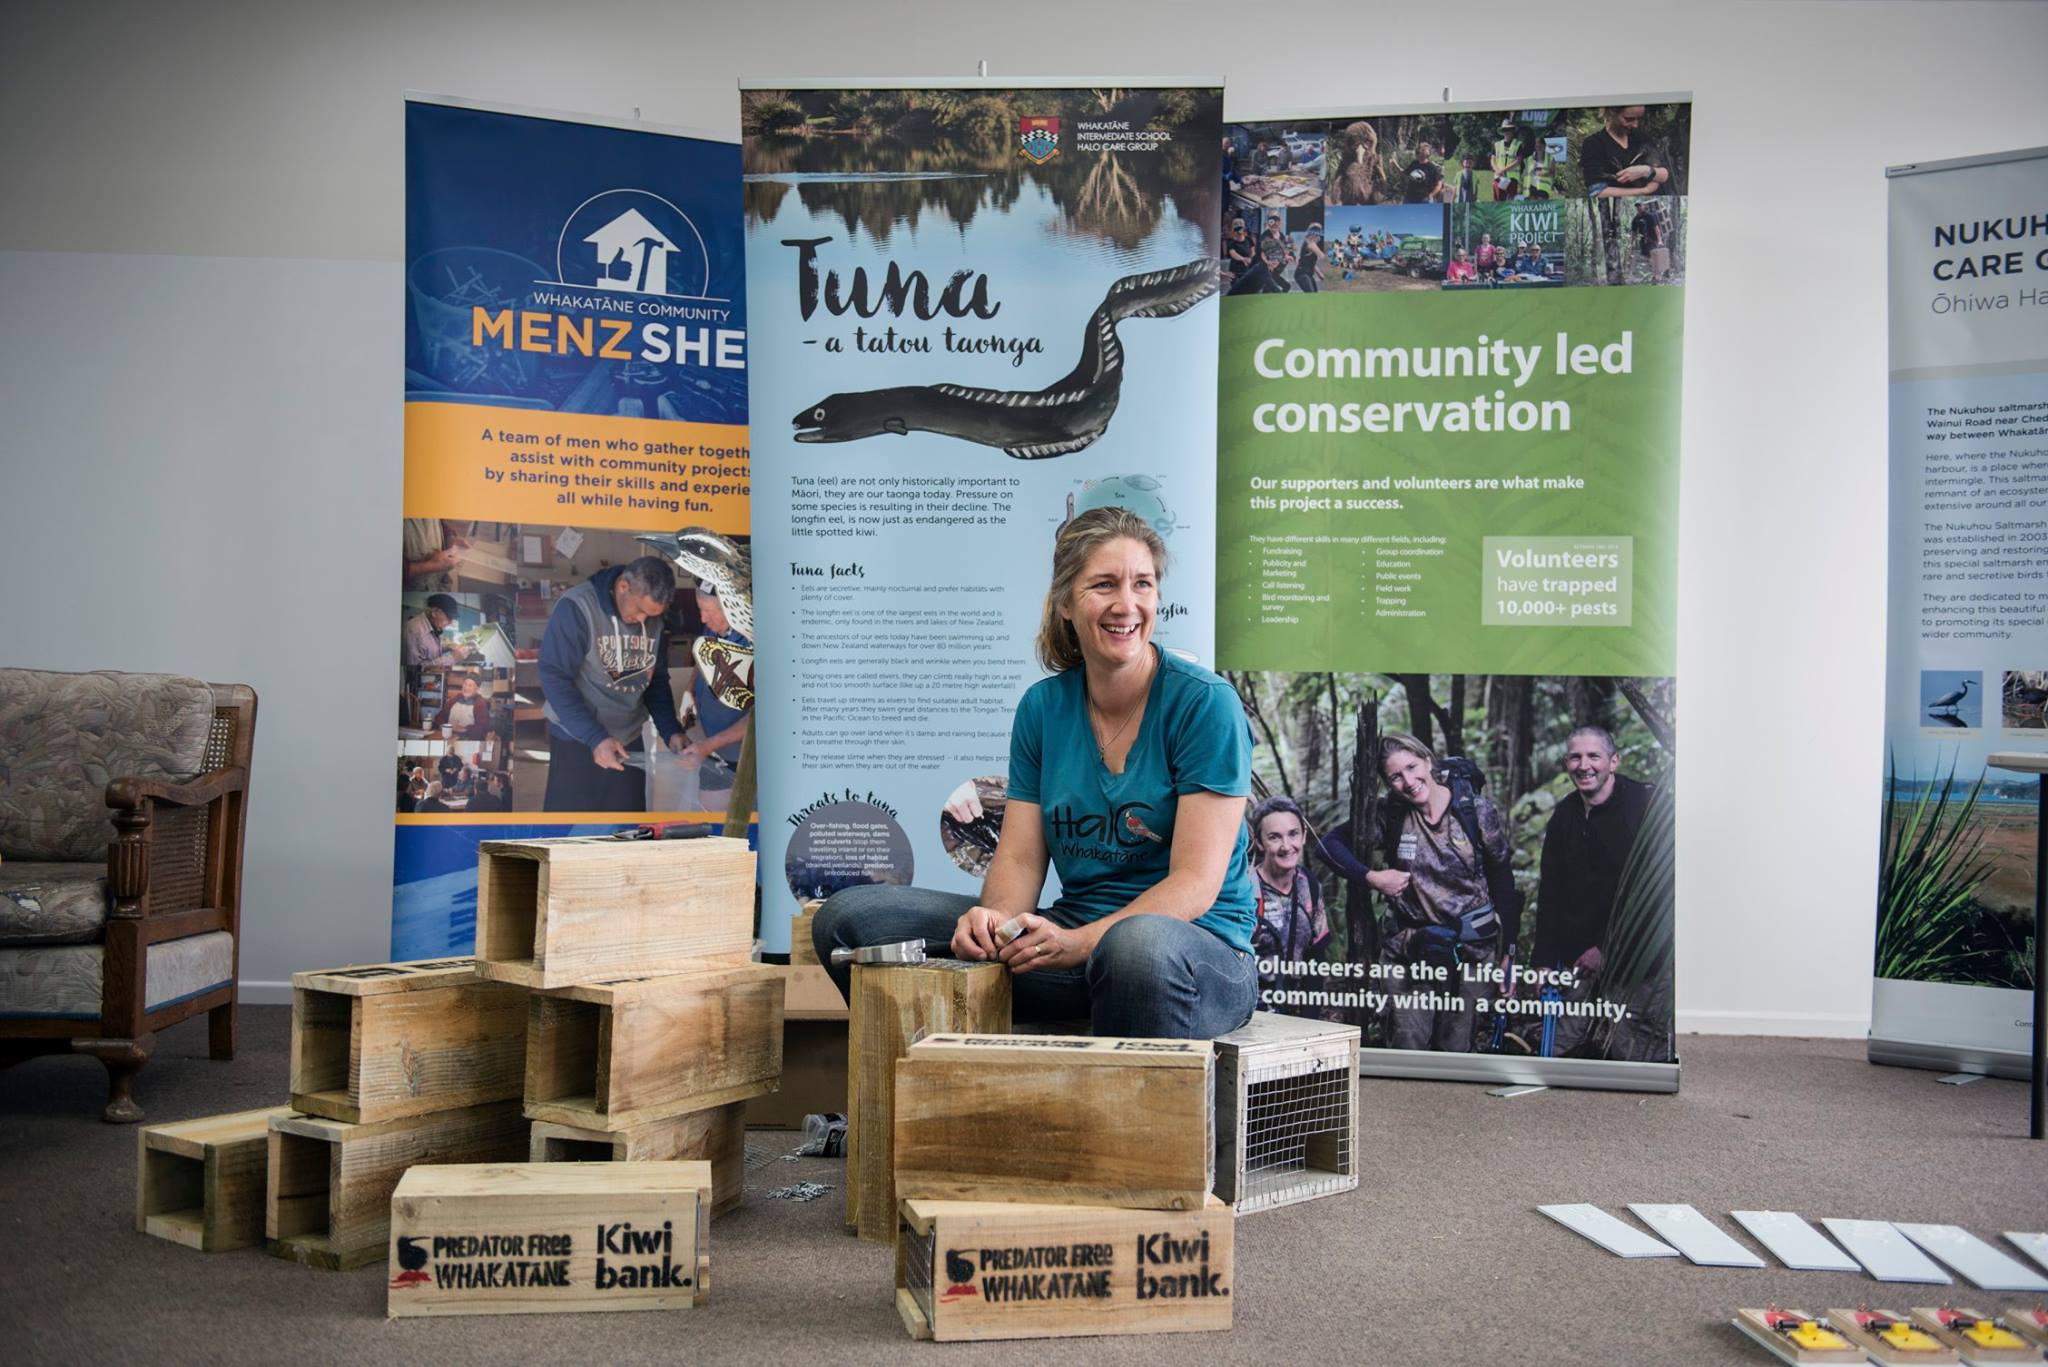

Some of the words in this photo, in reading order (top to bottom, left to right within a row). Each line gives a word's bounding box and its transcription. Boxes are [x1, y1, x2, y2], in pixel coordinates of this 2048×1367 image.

[1077, 132, 1134, 141] INTERMEDIATE
[1135, 132, 1171, 141] SCHOOL
[1077, 143, 1100, 151] HALO
[1102, 143, 1126, 151] CARE
[1127, 143, 1158, 151] GROUP
[1510, 213, 1558, 232] KIWI
[1934, 213, 2048, 248] NUKUH
[1510, 232, 1564, 245] PROJECT
[1933, 251, 2024, 281] CARE
[780, 236, 1001, 322] Tuna
[533, 291, 633, 313] WHAKATĀNE
[638, 302, 730, 322] COMMUNITY
[1932, 292, 2009, 314] Ōhiwa
[853, 326, 932, 354] tatou
[942, 326, 1045, 367] taonga
[1253, 334, 1542, 388] Community
[1556, 331, 1632, 375] led
[1252, 390, 1571, 433] conservation
[1927, 408, 1946, 416] The
[1949, 406, 1996, 415] Nukuhou
[1998, 402, 2048, 413] saltmarsh
[1927, 420, 1962, 428] Wainui
[1965, 418, 1992, 426] Road
[1995, 417, 2018, 425] near
[2021, 415, 2048, 424] Ched
[1926, 433, 1947, 441] way
[1950, 430, 1995, 440] between
[1998, 427, 2048, 438] Whakatān
[481, 428, 493, 442] A
[499, 430, 539, 445] team
[545, 434, 562, 447] of
[567, 438, 600, 451] men
[606, 439, 639, 453] who
[644, 441, 693, 459] gather
[699, 445, 750, 463] togeth
[510, 451, 554, 466] assist
[560, 454, 594, 468] with
[600, 457, 686, 477] community
[485, 467, 504, 482] by
[510, 469, 569, 487] sharing
[575, 473, 612, 488] their
[617, 476, 655, 491] skills
[660, 478, 688, 492] and
[693, 482, 750, 500] experie
[792, 477, 815, 487] Tuna
[817, 476, 838, 487] (eel)
[841, 478, 857, 486] are
[859, 478, 876, 486] not
[878, 477, 900, 488] only
[902, 477, 956, 488] historically
[958, 477, 1006, 488] important
[1009, 477, 1020, 487] to
[1250, 476, 1278, 490] Our
[1280, 476, 1359, 494] supporters
[1362, 475, 1390, 490] and
[1394, 475, 1471, 490] volunteers
[1474, 479, 1499, 490] are
[1502, 475, 1540, 489] what
[1543, 475, 1585, 490] make
[557, 491, 575, 505] all
[581, 493, 622, 508] while
[628, 496, 679, 513] having
[684, 498, 713, 513] fun.
[824, 490, 846, 500] they
[848, 491, 864, 499] are
[866, 491, 884, 499] our
[886, 490, 921, 501] taonga
[923, 490, 953, 500] today.
[956, 490, 998, 499] Pressure
[1000, 491, 1014, 499] on
[1250, 496, 1276, 509] this
[1279, 496, 1331, 513] project
[1334, 499, 1343, 509] a
[1346, 498, 1404, 509] success.
[820, 503, 857, 514] species
[859, 503, 867, 511] is
[869, 502, 913, 513] resulting
[915, 503, 924, 511] in
[926, 503, 949, 512] their
[951, 503, 990, 512] decline.
[993, 503, 1012, 512] The
[792, 515, 826, 525] longfin
[828, 515, 845, 525] eel,
[848, 516, 856, 524] is
[858, 516, 880, 524] now
[882, 515, 900, 526] just
[916, 515, 975, 526] endangered
[977, 517, 988, 525] as
[990, 515, 1006, 525] the
[792, 528, 813, 537] little
[815, 528, 853, 538] spotted
[855, 528, 878, 537] kiwi.
[1249, 536, 1265, 544] They
[1284, 535, 1314, 543] different
[1315, 535, 1331, 543] skills
[1340, 537, 1360, 545] many
[1376, 549, 1399, 557] Group
[1400, 548, 1444, 556] coordination
[1496, 549, 1619, 569] Volunteers
[790, 562, 824, 577] Tuna
[830, 562, 866, 580] facts
[1376, 573, 1397, 581] Public
[1398, 573, 1422, 581] events
[1497, 576, 1539, 593] have
[1543, 576, 1618, 596] trapped
[1376, 597, 1407, 606] Trapping
[1497, 600, 1567, 617] 10,000+
[1571, 601, 1617, 618] pests
[1156, 603, 1188, 622] gfin
[1376, 609, 1426, 617] Administration
[786, 789, 839, 828] Threats
[845, 787, 860, 802] to
[867, 790, 899, 820] tuna
[1369, 963, 1406, 980] are
[1409, 961, 1448, 981] the
[1262, 988, 1387, 1013] community
[1393, 991, 1465, 1012] within
[1475, 999, 1489, 1013] a
[1494, 998, 1632, 1023] community.
[433, 1234, 524, 1259] PREDATOR
[597, 1221, 673, 1255] Kiwi
[1136, 1230, 1210, 1265] Kiwi
[980, 1246, 1069, 1272] PREDATOR
[596, 1255, 692, 1290] bank.
[1136, 1264, 1230, 1300] bank.
